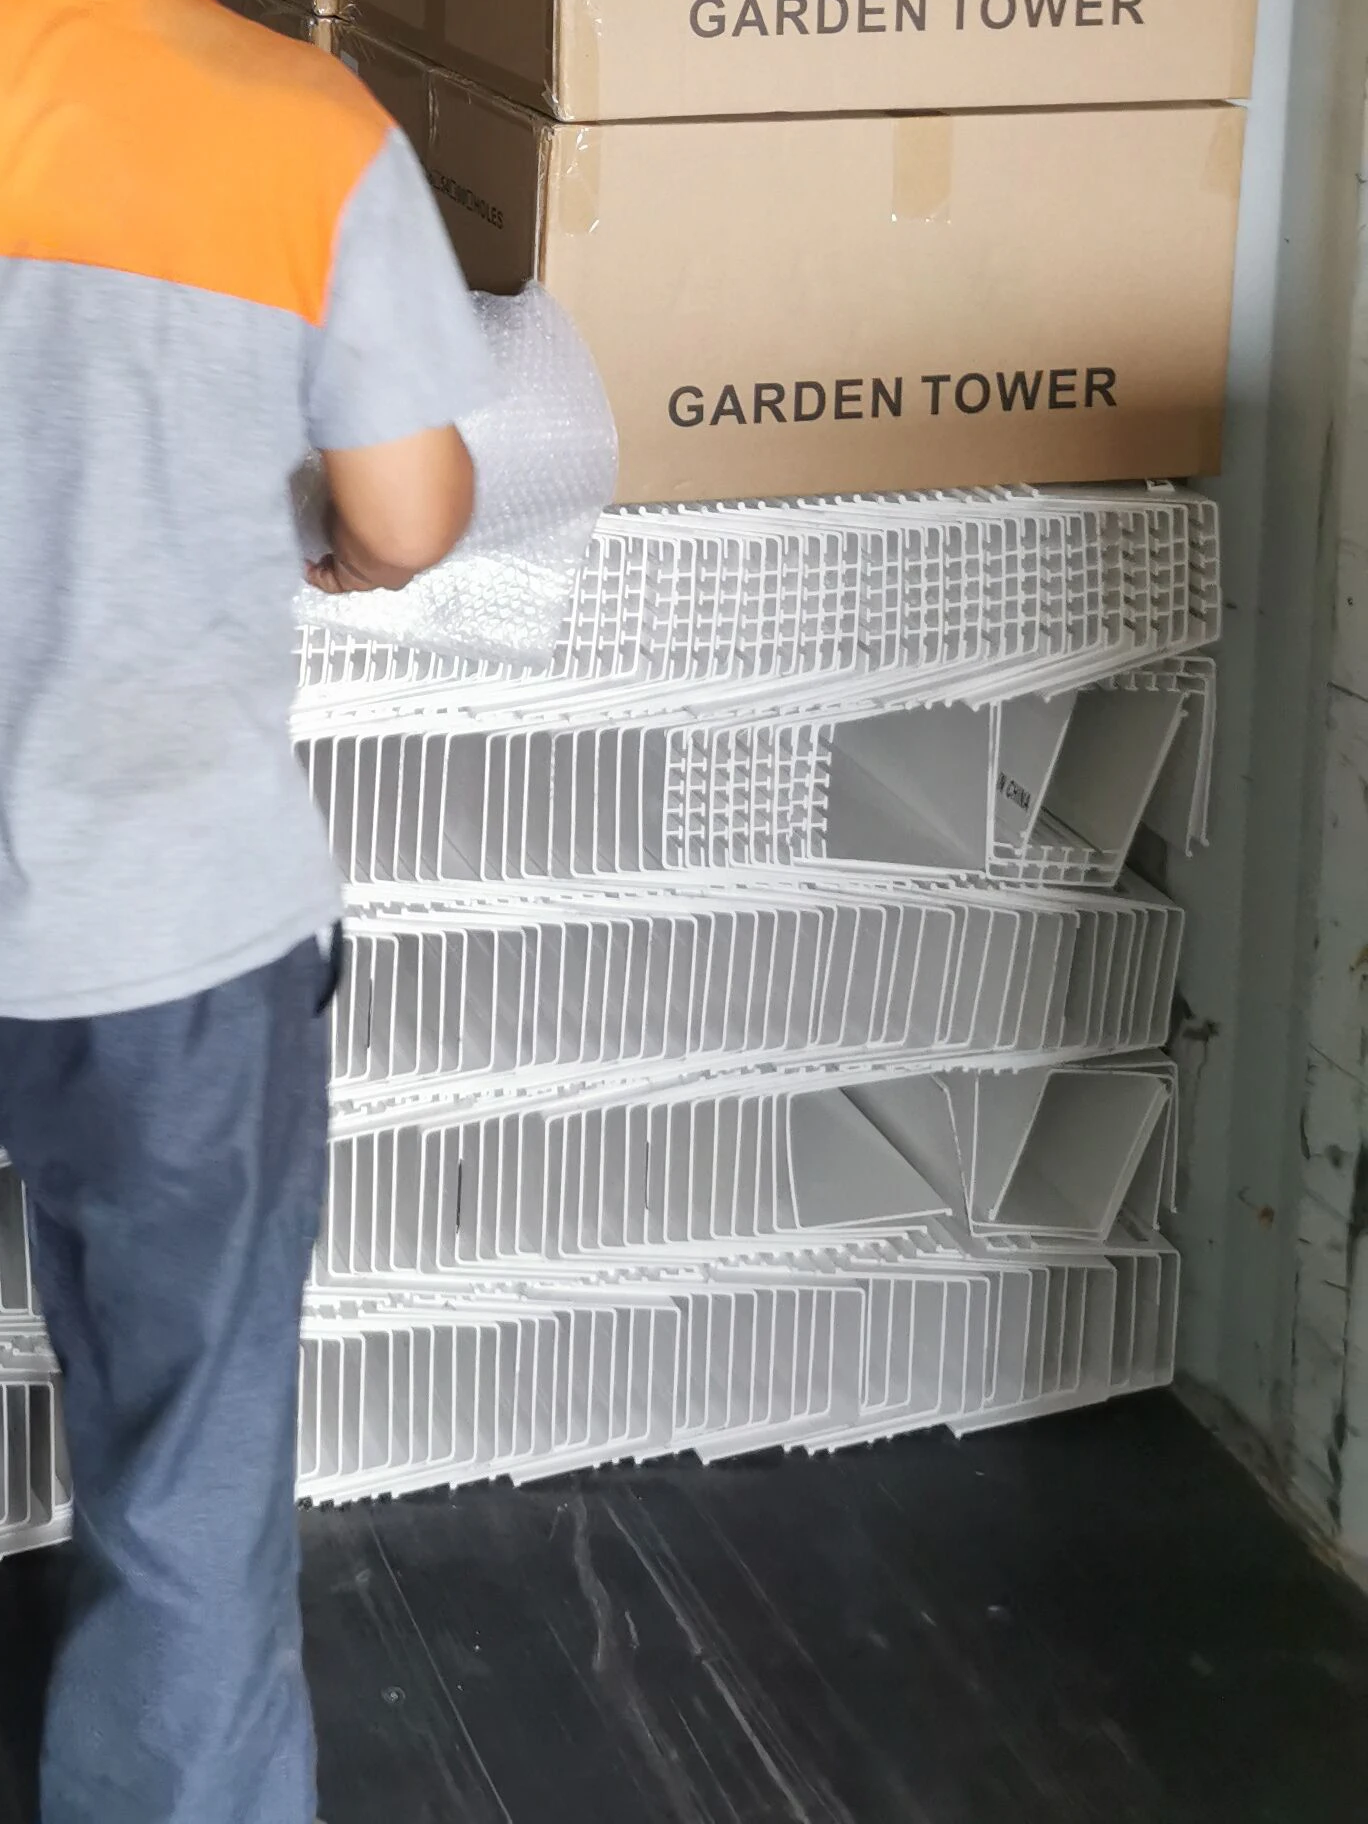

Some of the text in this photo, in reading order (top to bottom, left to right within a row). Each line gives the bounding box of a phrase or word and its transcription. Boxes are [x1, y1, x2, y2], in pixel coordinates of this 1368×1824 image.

[668, 367, 1118, 428] GARDEN TOWER
[1006, 779, 1031, 812] CHINA
